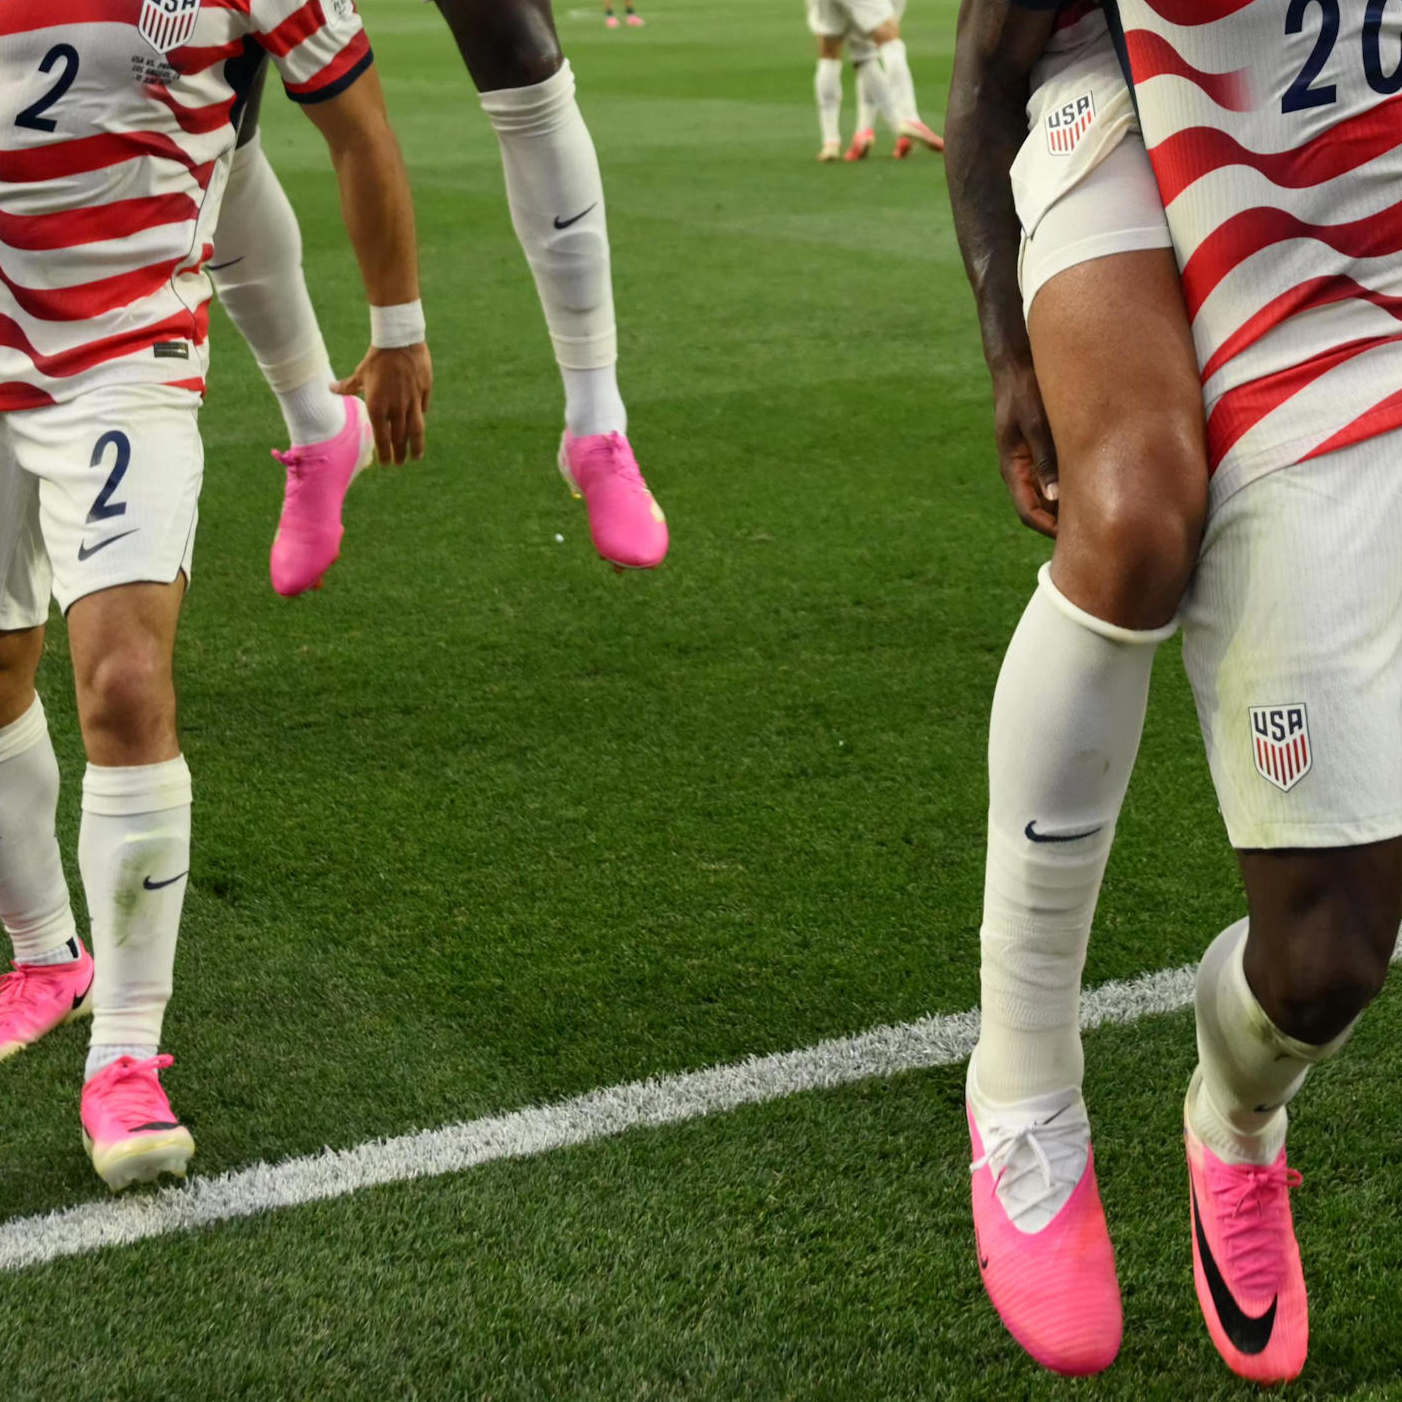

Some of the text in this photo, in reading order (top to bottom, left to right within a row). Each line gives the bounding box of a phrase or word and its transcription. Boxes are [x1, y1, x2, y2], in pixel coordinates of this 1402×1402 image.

[14, 43, 80, 132] 2
[1047, 95, 1091, 129] USA
[85, 430, 131, 524] 2
[1254, 708, 1303, 742] USA
